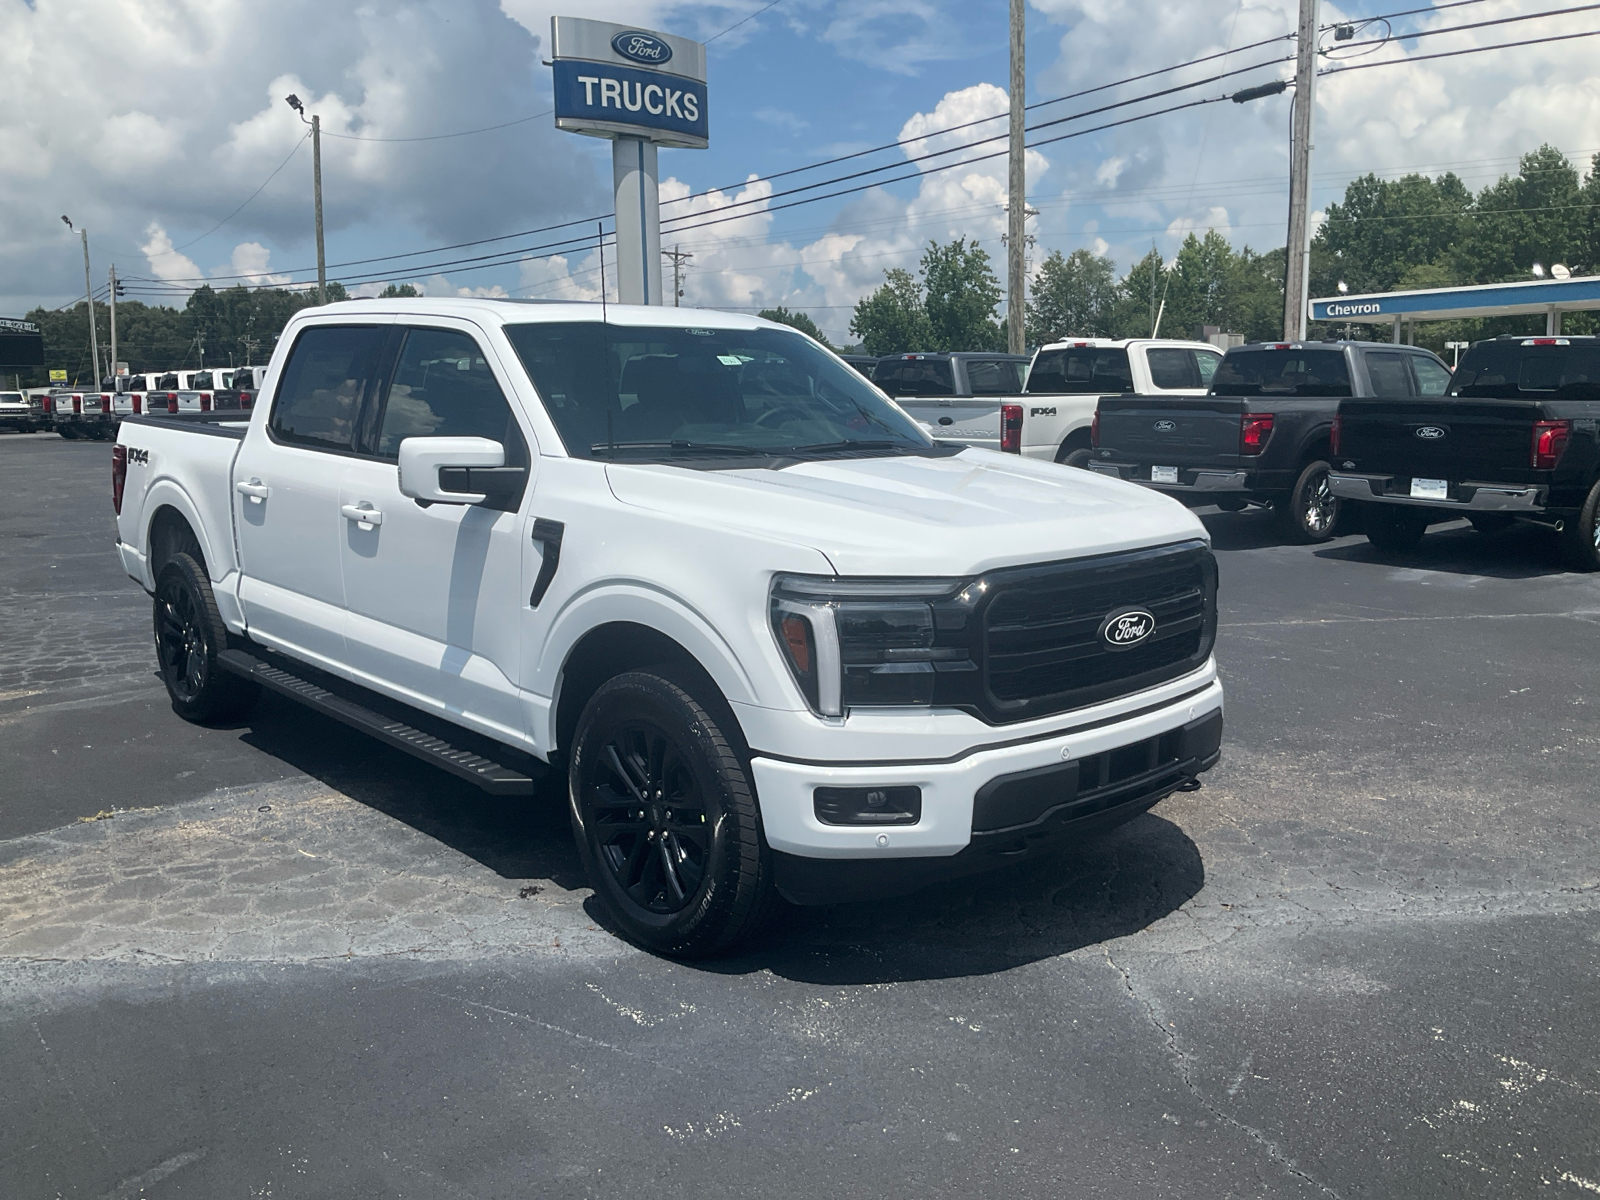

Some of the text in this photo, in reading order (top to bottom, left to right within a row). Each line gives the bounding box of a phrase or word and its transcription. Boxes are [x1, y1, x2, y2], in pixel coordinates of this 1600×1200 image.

[628, 36, 660, 59] Ford
[578, 76, 699, 122] TRUCKS
[1326, 303, 1380, 316] Chevron
[1030, 407, 1057, 417] FX4
[953, 429, 994, 437] DUTY
[127, 447, 149, 464] FX4
[1115, 616, 1146, 640] Ford
